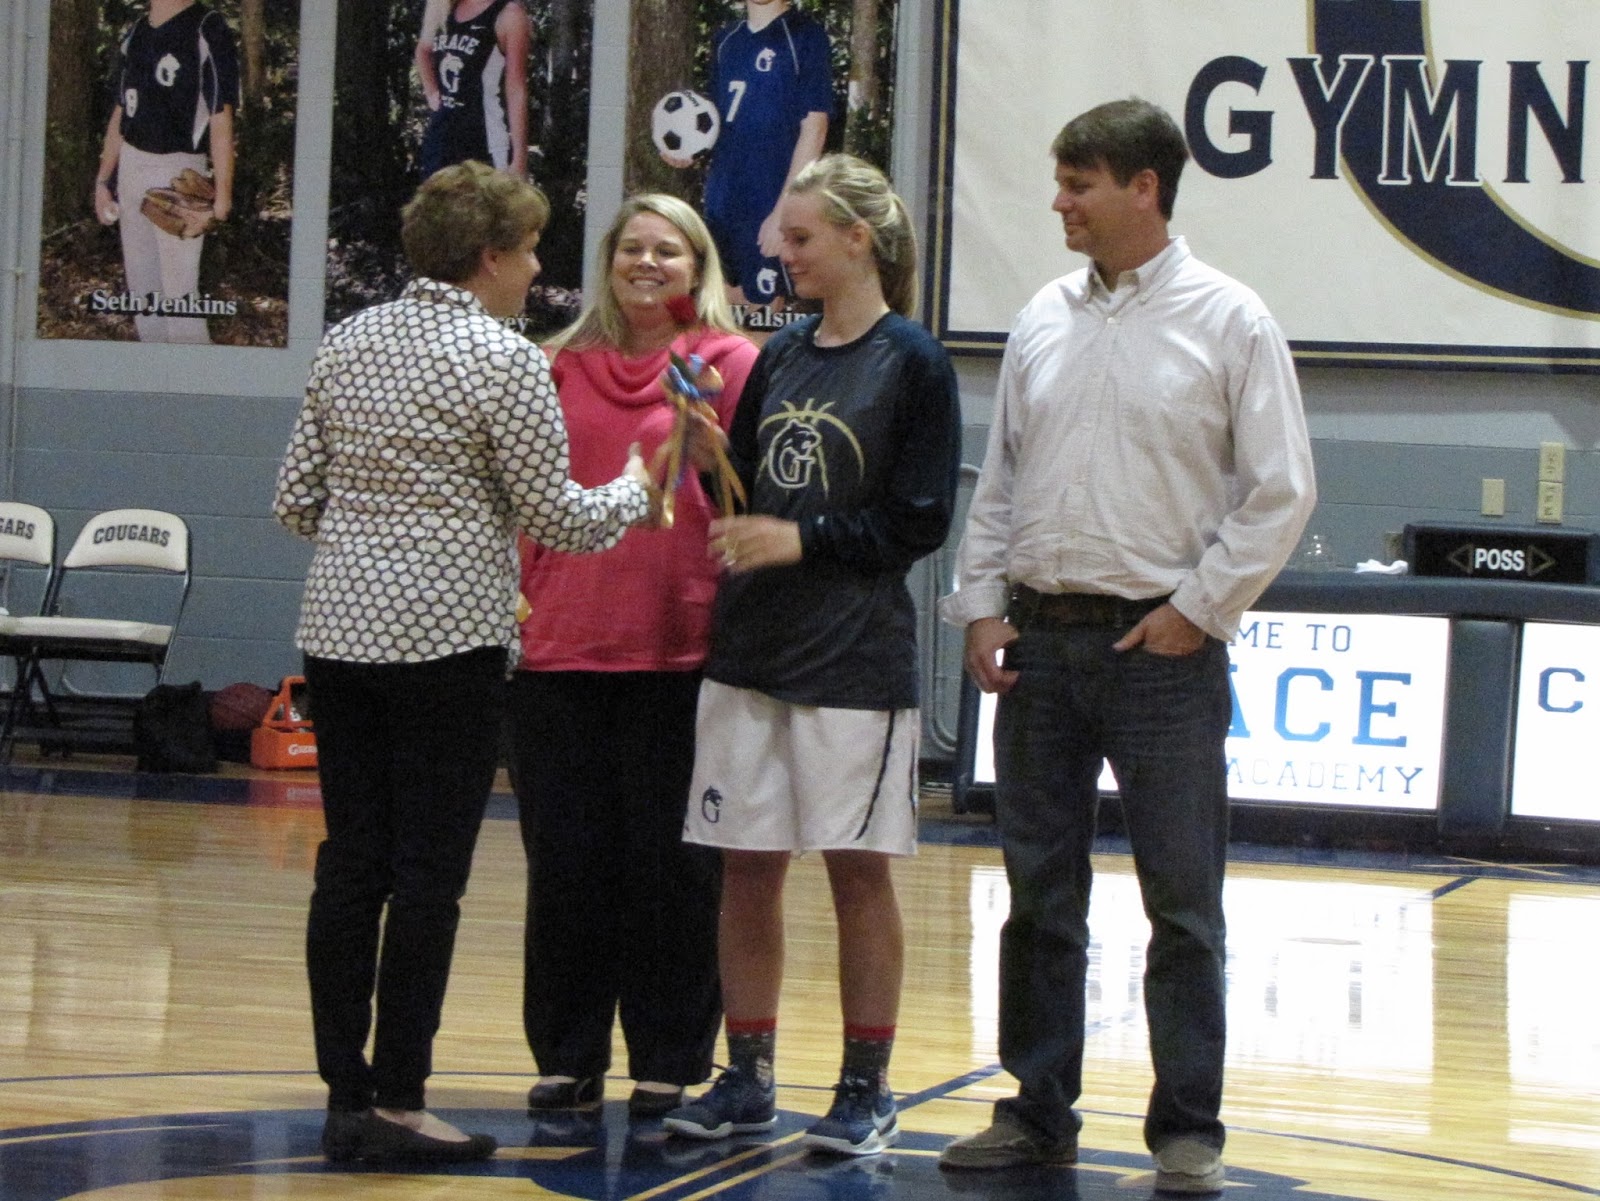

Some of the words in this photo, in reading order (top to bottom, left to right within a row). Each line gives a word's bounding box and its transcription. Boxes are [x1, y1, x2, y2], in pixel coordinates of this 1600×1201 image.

[725, 80, 747, 122] 7
[1184, 54, 1590, 187] GYMN
[92, 289, 142, 312] Seth
[148, 291, 238, 315] Jenkins
[495, 316, 531, 335] ey
[731, 304, 822, 328] Walsi
[93, 524, 171, 548] COUGARS
[1474, 547, 1526, 571] POSS
[1306, 624, 1352, 652] TO
[1226, 757, 1424, 795] ACADEMY
